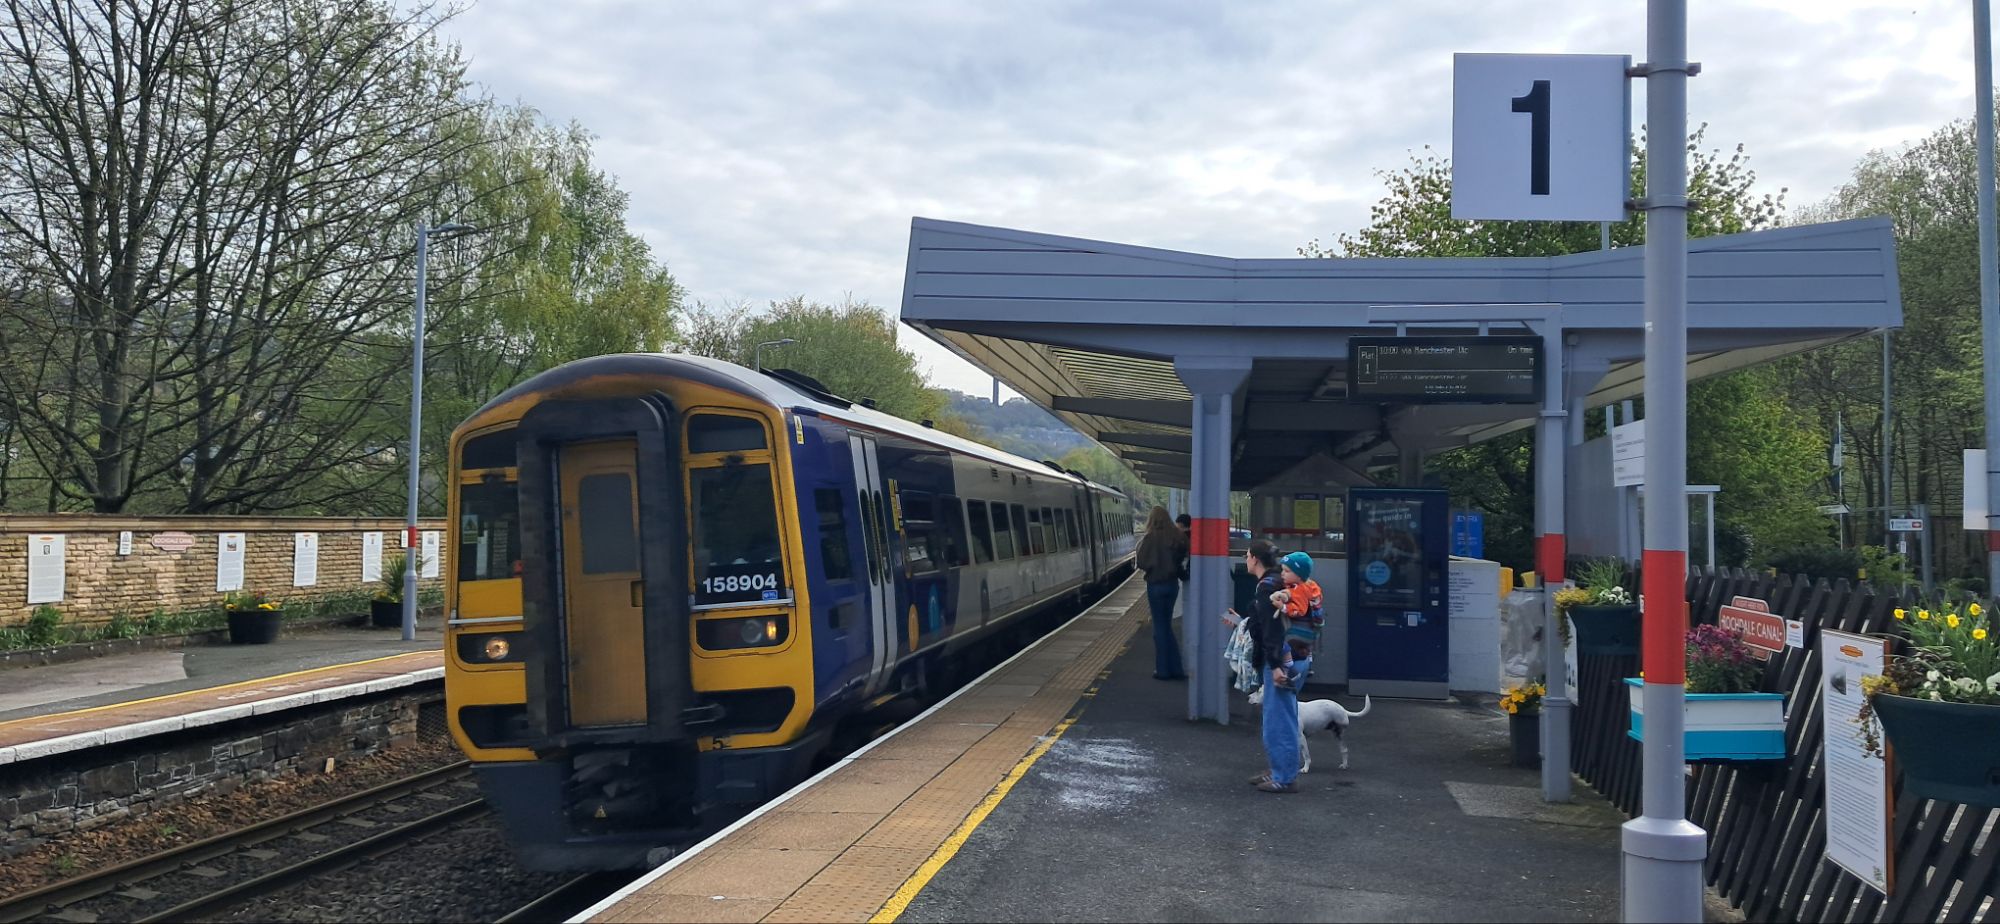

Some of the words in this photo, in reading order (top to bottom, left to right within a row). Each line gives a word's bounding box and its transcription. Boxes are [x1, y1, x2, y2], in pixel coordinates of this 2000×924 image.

[1512, 80, 1551, 196] 1
[1361, 351, 1375, 360] Plat
[1365, 363, 1370, 375] 1
[703, 573, 777, 594] 158904
[1757, 622, 1781, 642] CANAL
